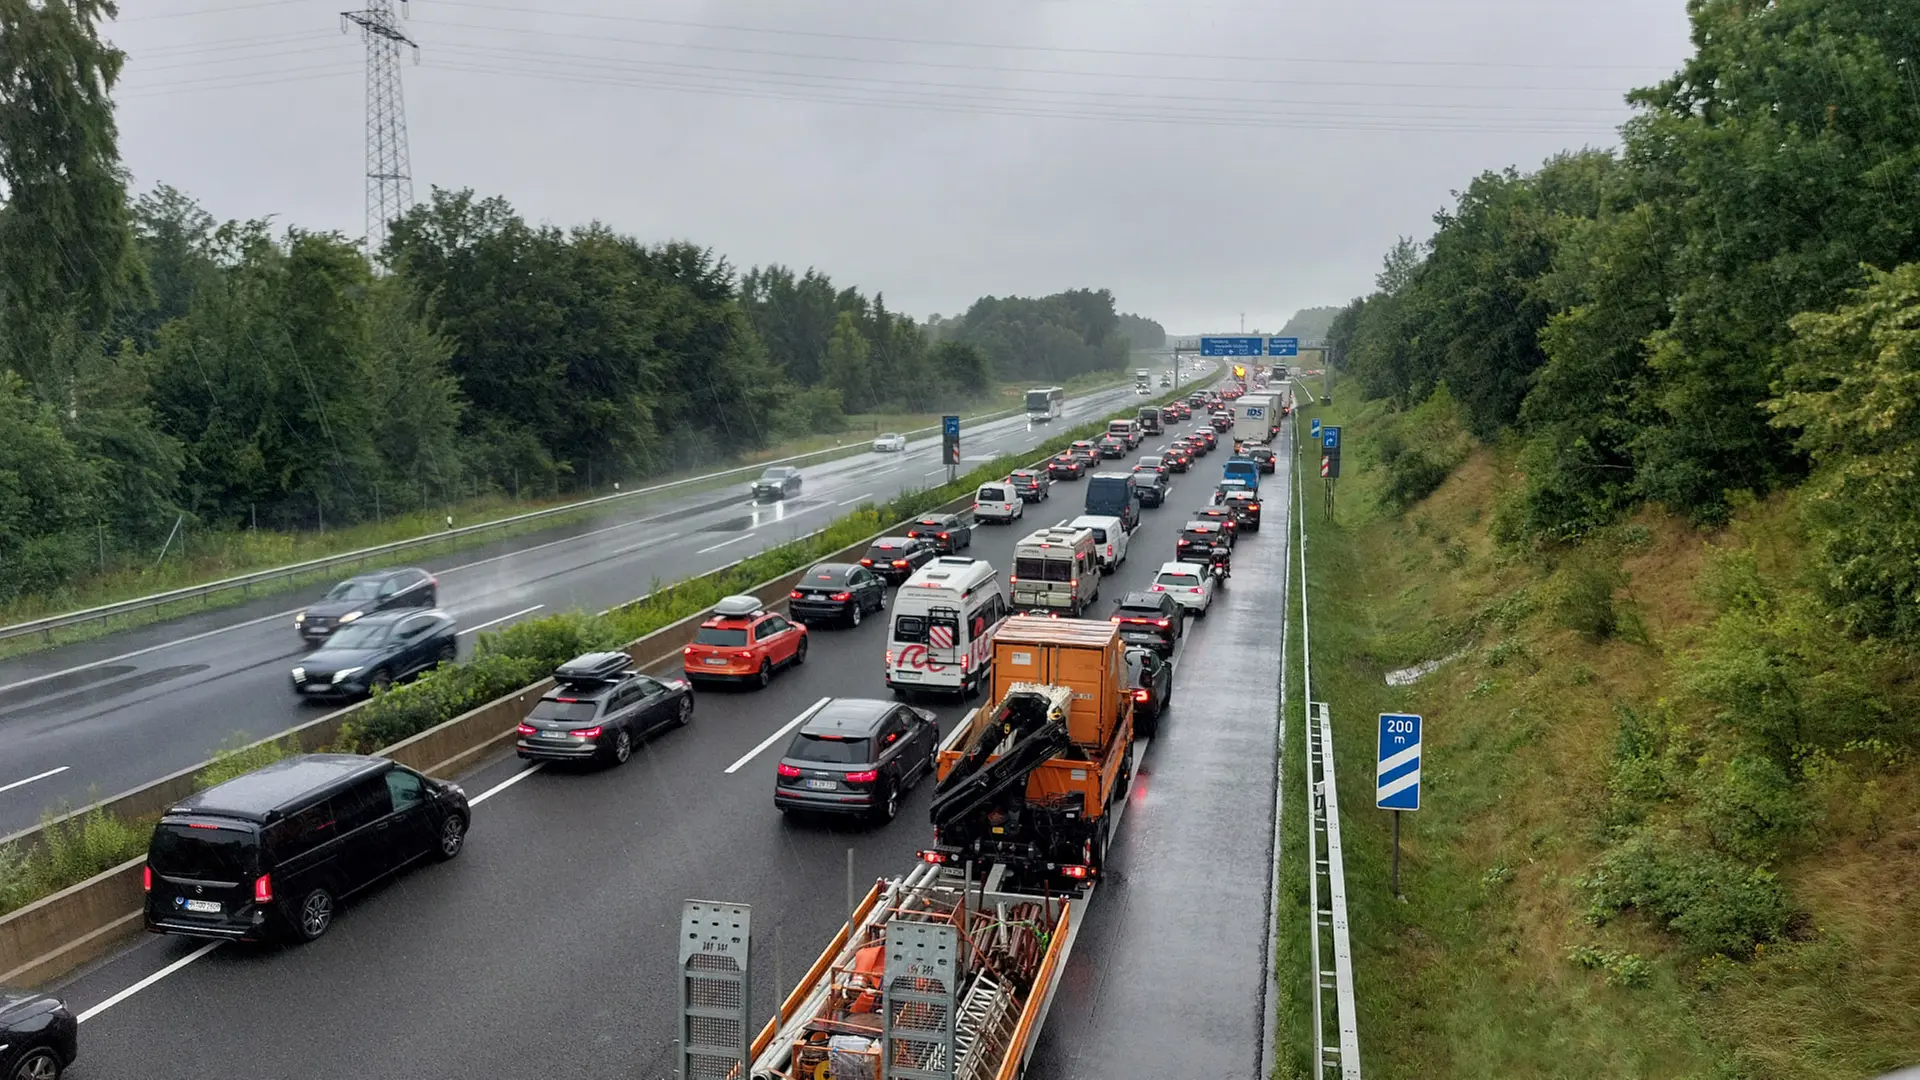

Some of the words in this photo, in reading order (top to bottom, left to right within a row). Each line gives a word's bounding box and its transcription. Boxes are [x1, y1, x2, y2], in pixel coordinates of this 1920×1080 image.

[1246, 408, 1263, 417] IDS
[1386, 720, 1413, 734] 200
[1394, 736, 1406, 744] m
